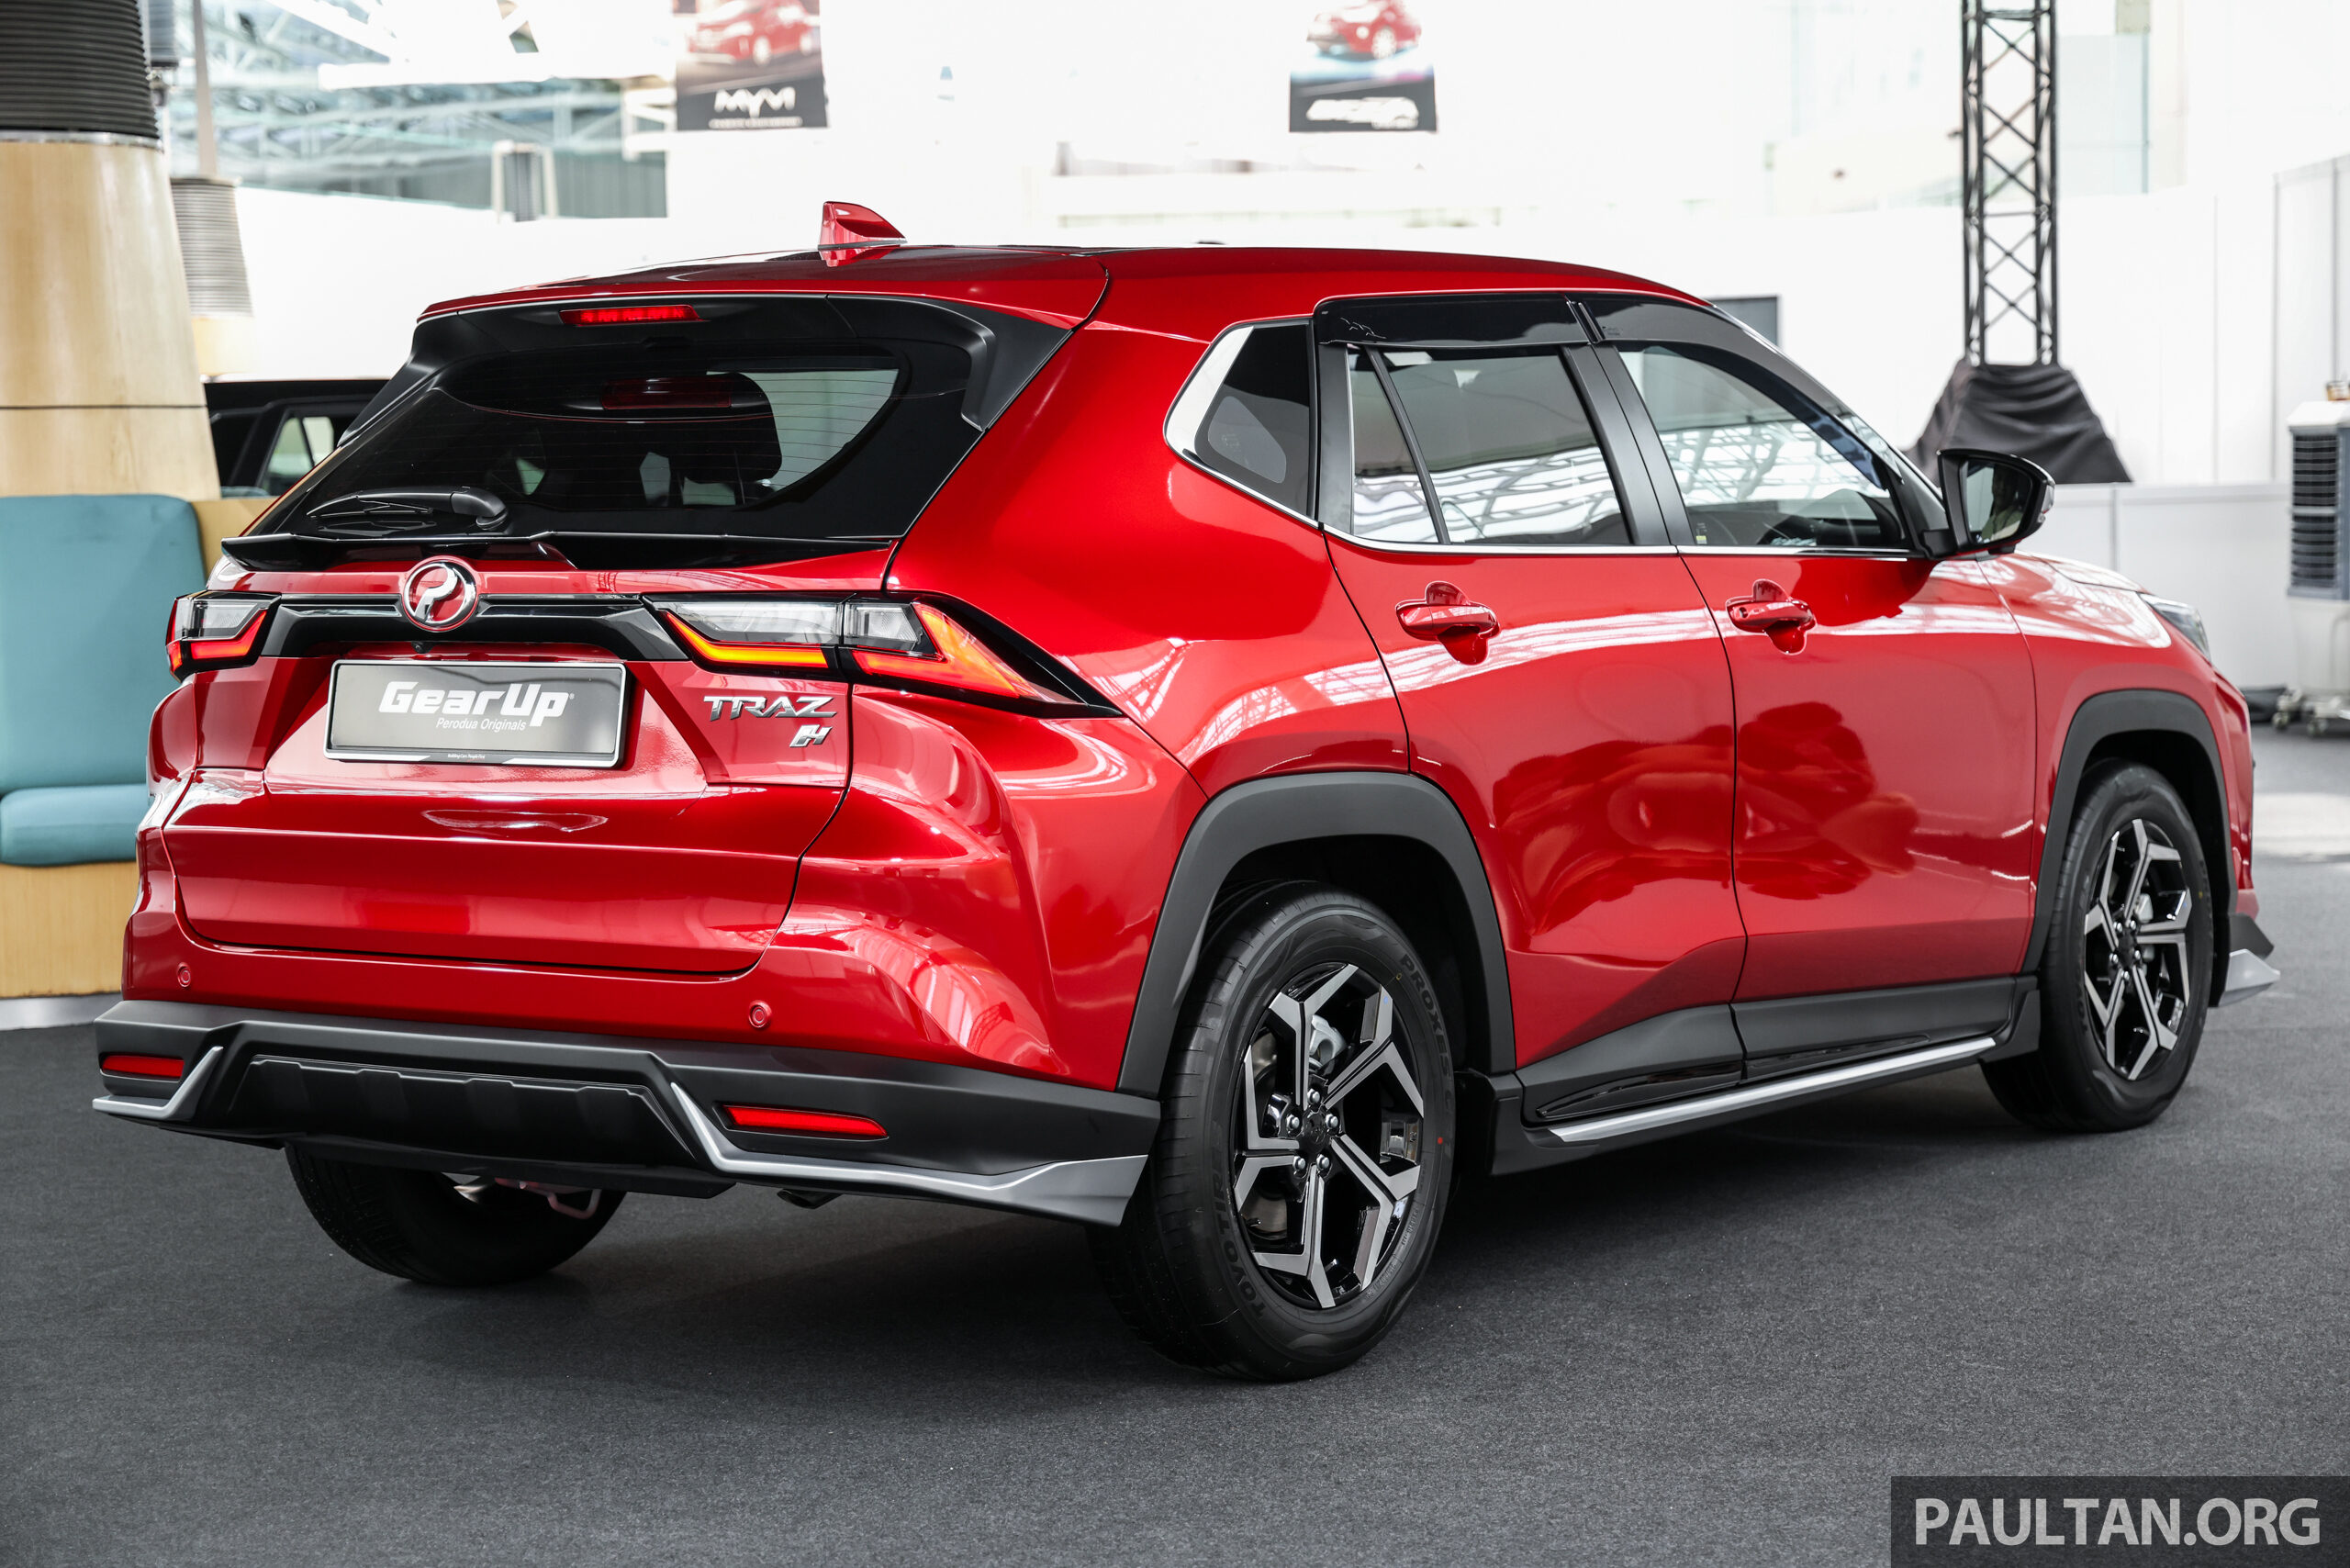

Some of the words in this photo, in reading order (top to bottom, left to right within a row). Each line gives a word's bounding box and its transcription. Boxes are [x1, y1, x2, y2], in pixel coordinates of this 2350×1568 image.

[435, 717, 478, 730] Perodua
[480, 719, 527, 733] Originals
[703, 695, 838, 722] TRAZ
[1399, 954, 1450, 1078] PROXES
[1223, 1239, 1266, 1318] TOYO
